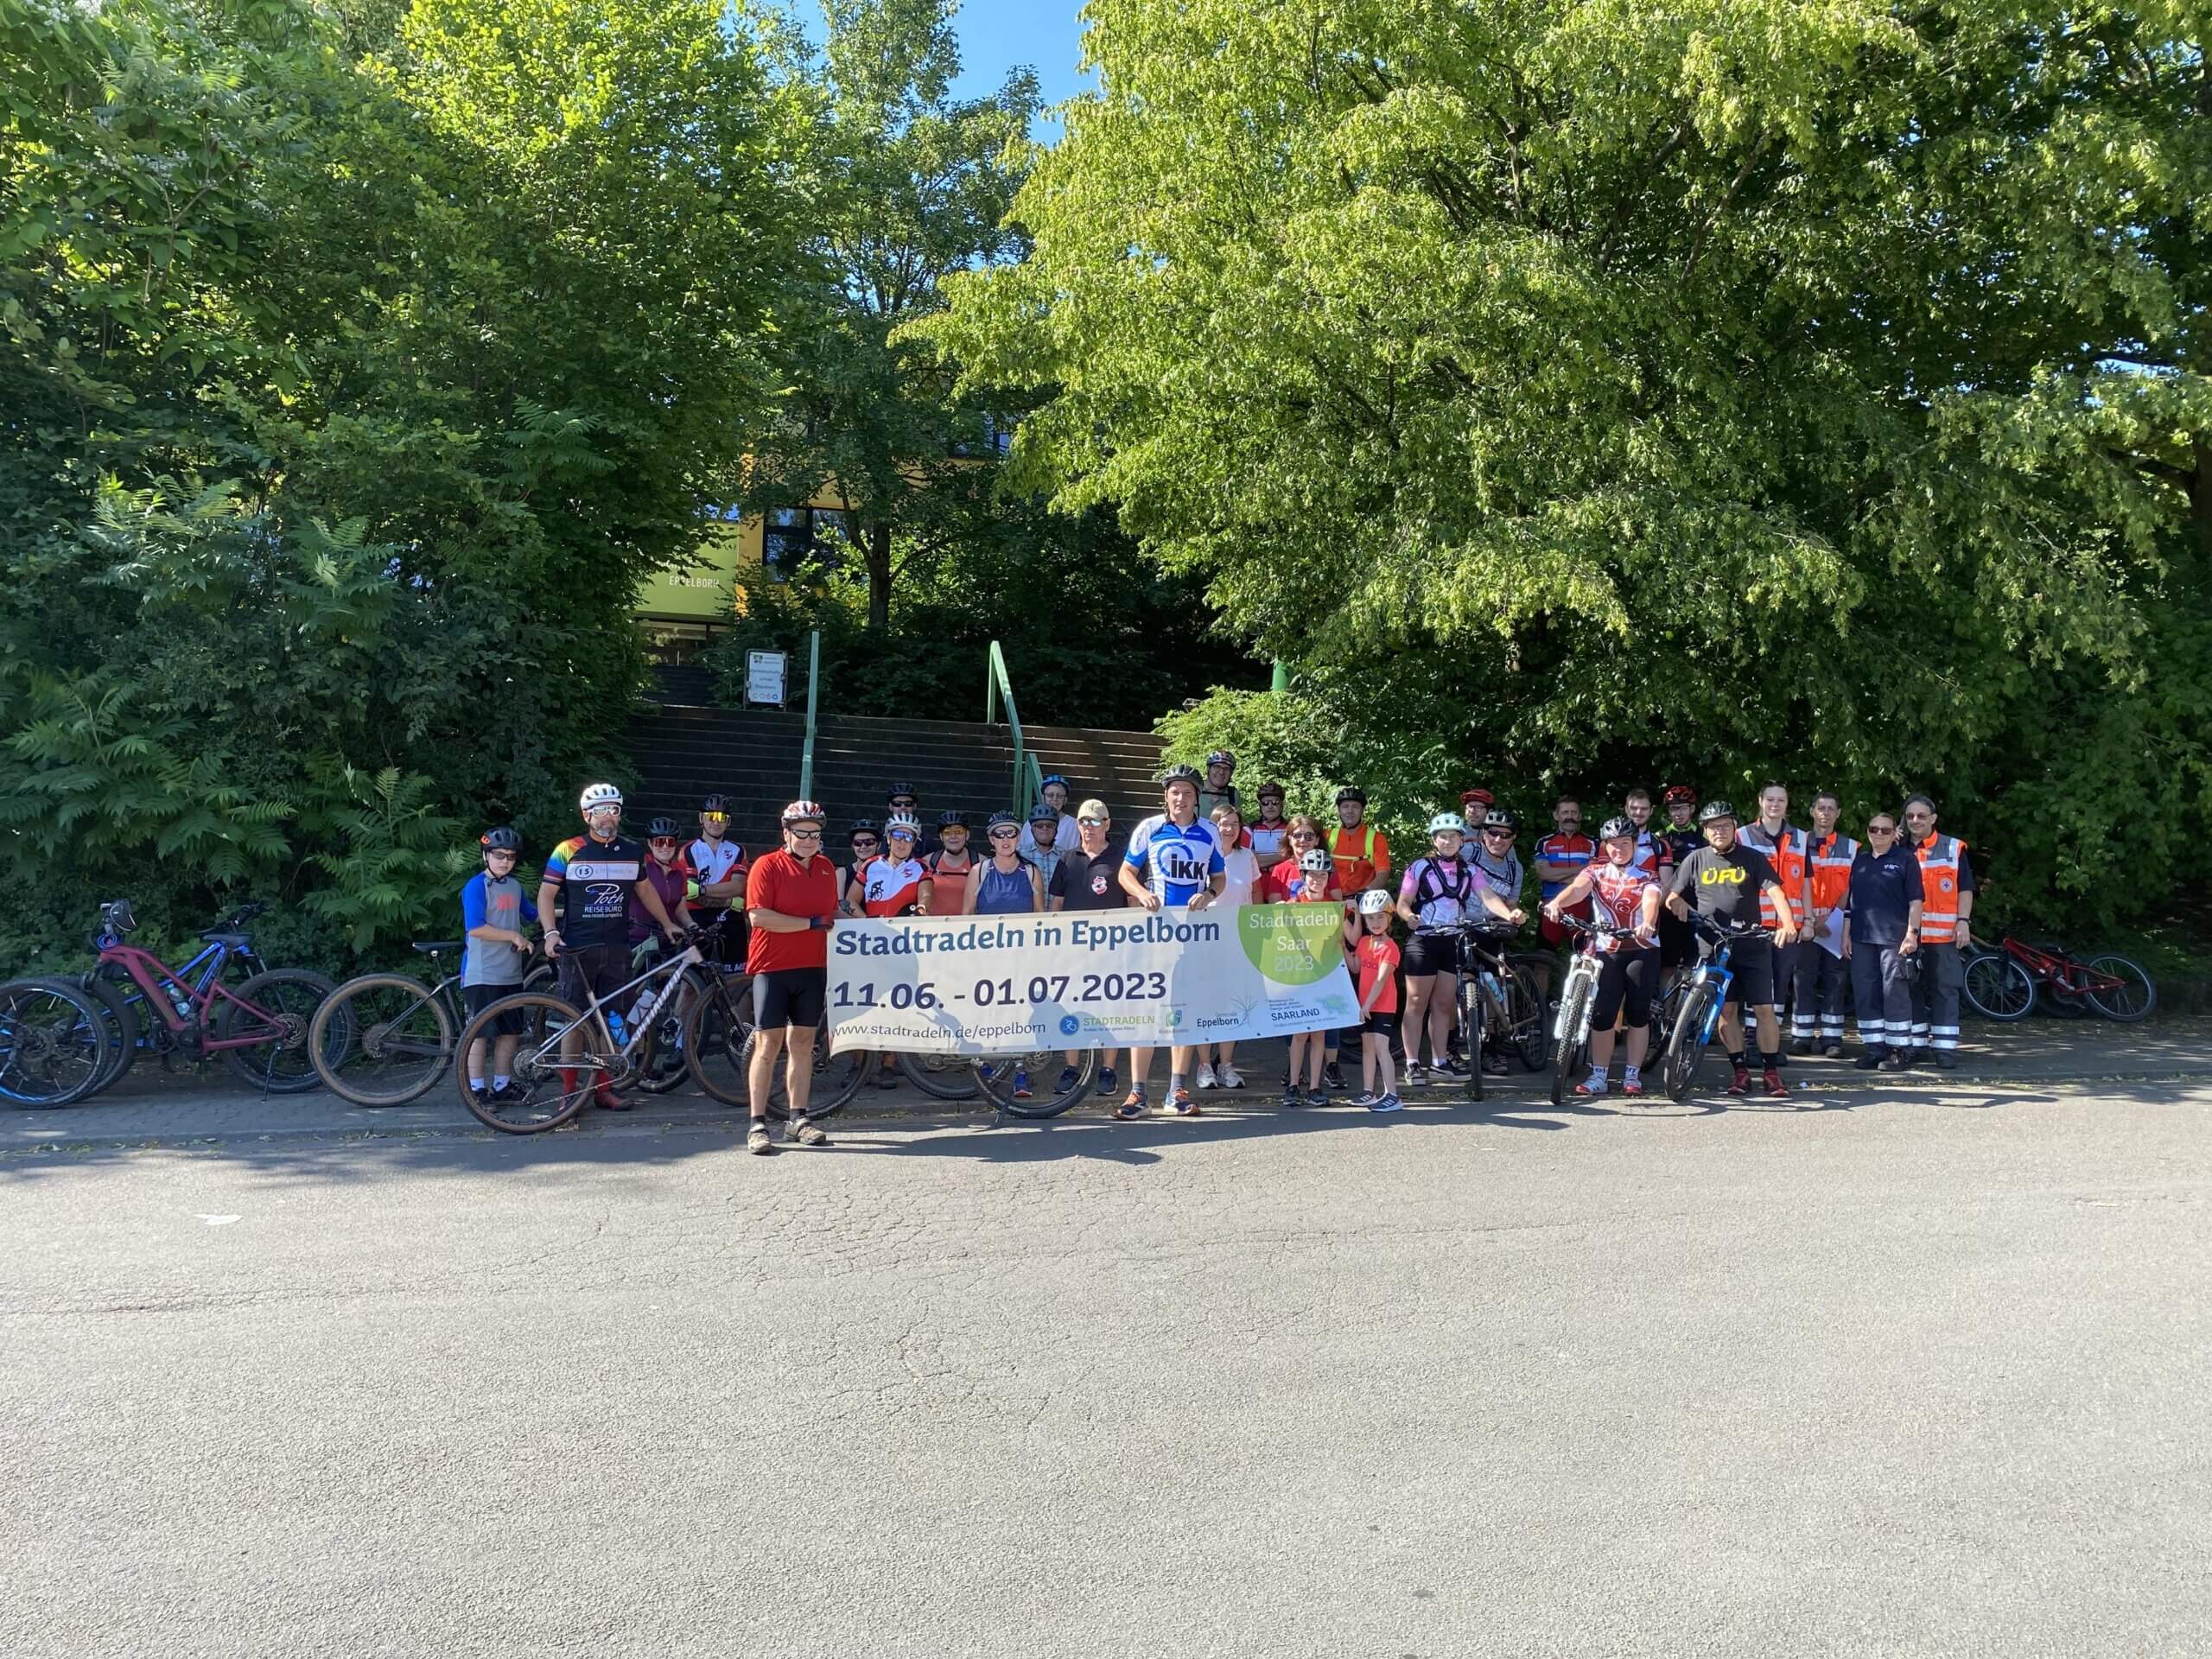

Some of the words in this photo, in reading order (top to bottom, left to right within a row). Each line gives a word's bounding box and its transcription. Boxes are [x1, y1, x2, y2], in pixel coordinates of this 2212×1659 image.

[1701, 867, 1746, 885] ÜFÜ
[584, 904, 623, 913] REISEBÜRO
[1249, 910, 1339, 929] Stadtradeln
[836, 922, 1024, 956] Stadtradeln
[1034, 921, 1062, 947] in
[1071, 916, 1220, 951] Eppelborn
[1277, 936, 1313, 951] Saar
[1274, 955, 1314, 972] 2023
[833, 982, 944, 1010] 11.06.
[973, 972, 1166, 1007] 01.07.2023
[1083, 1015, 1155, 1027] STADTRADELN
[1197, 1017, 1239, 1028] Eppelborn
[1271, 1007, 1320, 1021] SAARLAND
[831, 1021, 1046, 1039] www.stadtradeln.de/eppelborn
